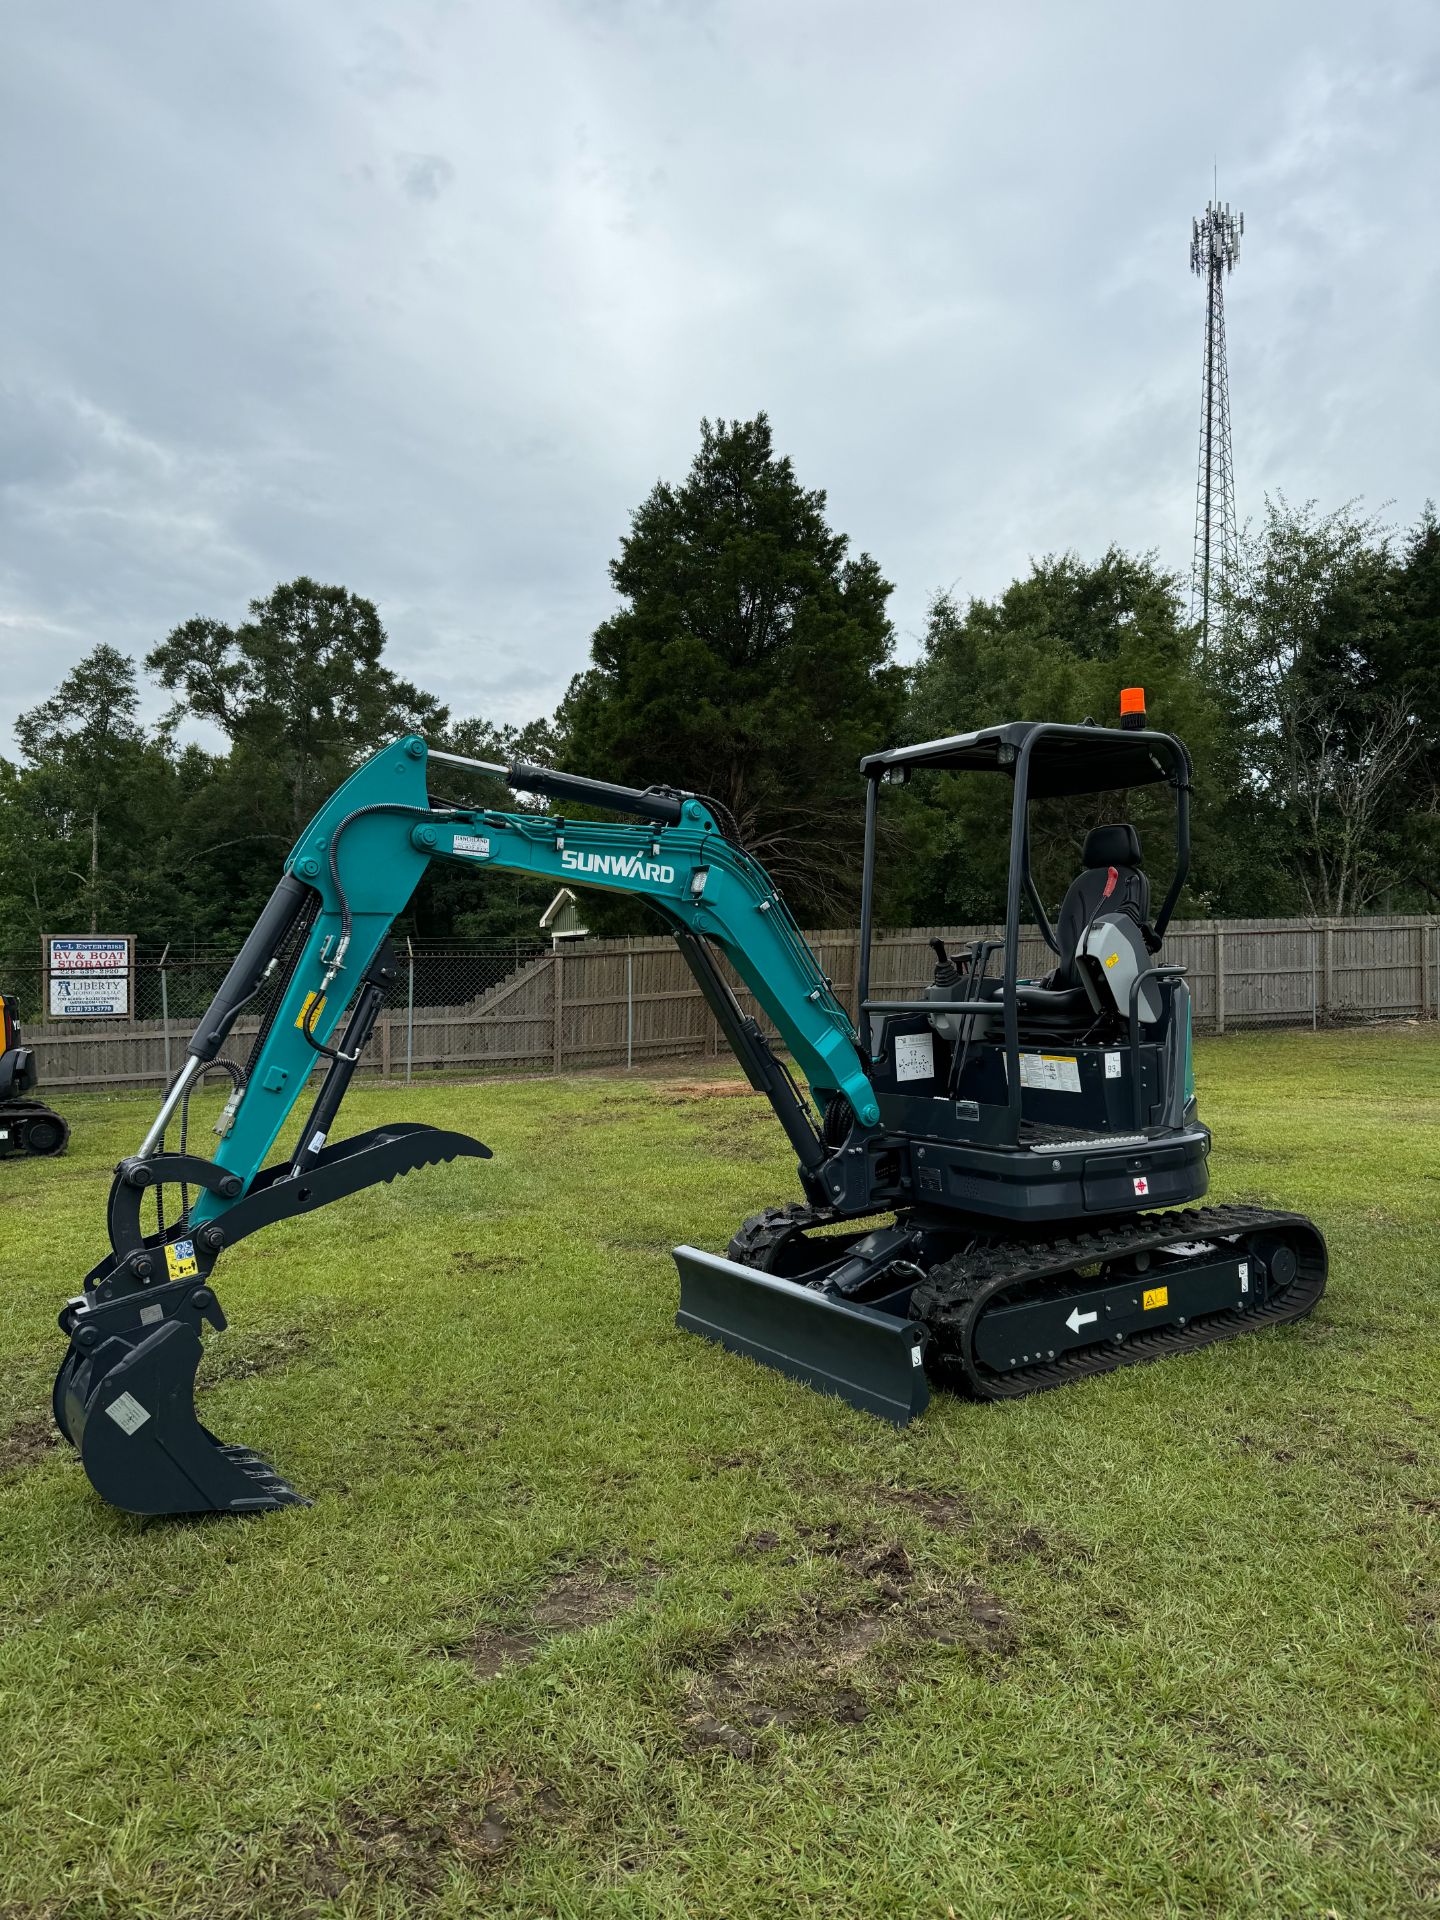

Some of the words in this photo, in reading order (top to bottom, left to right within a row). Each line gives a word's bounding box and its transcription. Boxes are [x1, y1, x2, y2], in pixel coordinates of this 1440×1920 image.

[561, 850, 675, 884] SUNWARD
[53, 951, 71, 960] RV
[75, 951, 86, 960] &
[89, 951, 126, 960] BOAT
[57, 960, 121, 968] STORAGE
[73, 981, 121, 991] LIBERTY
